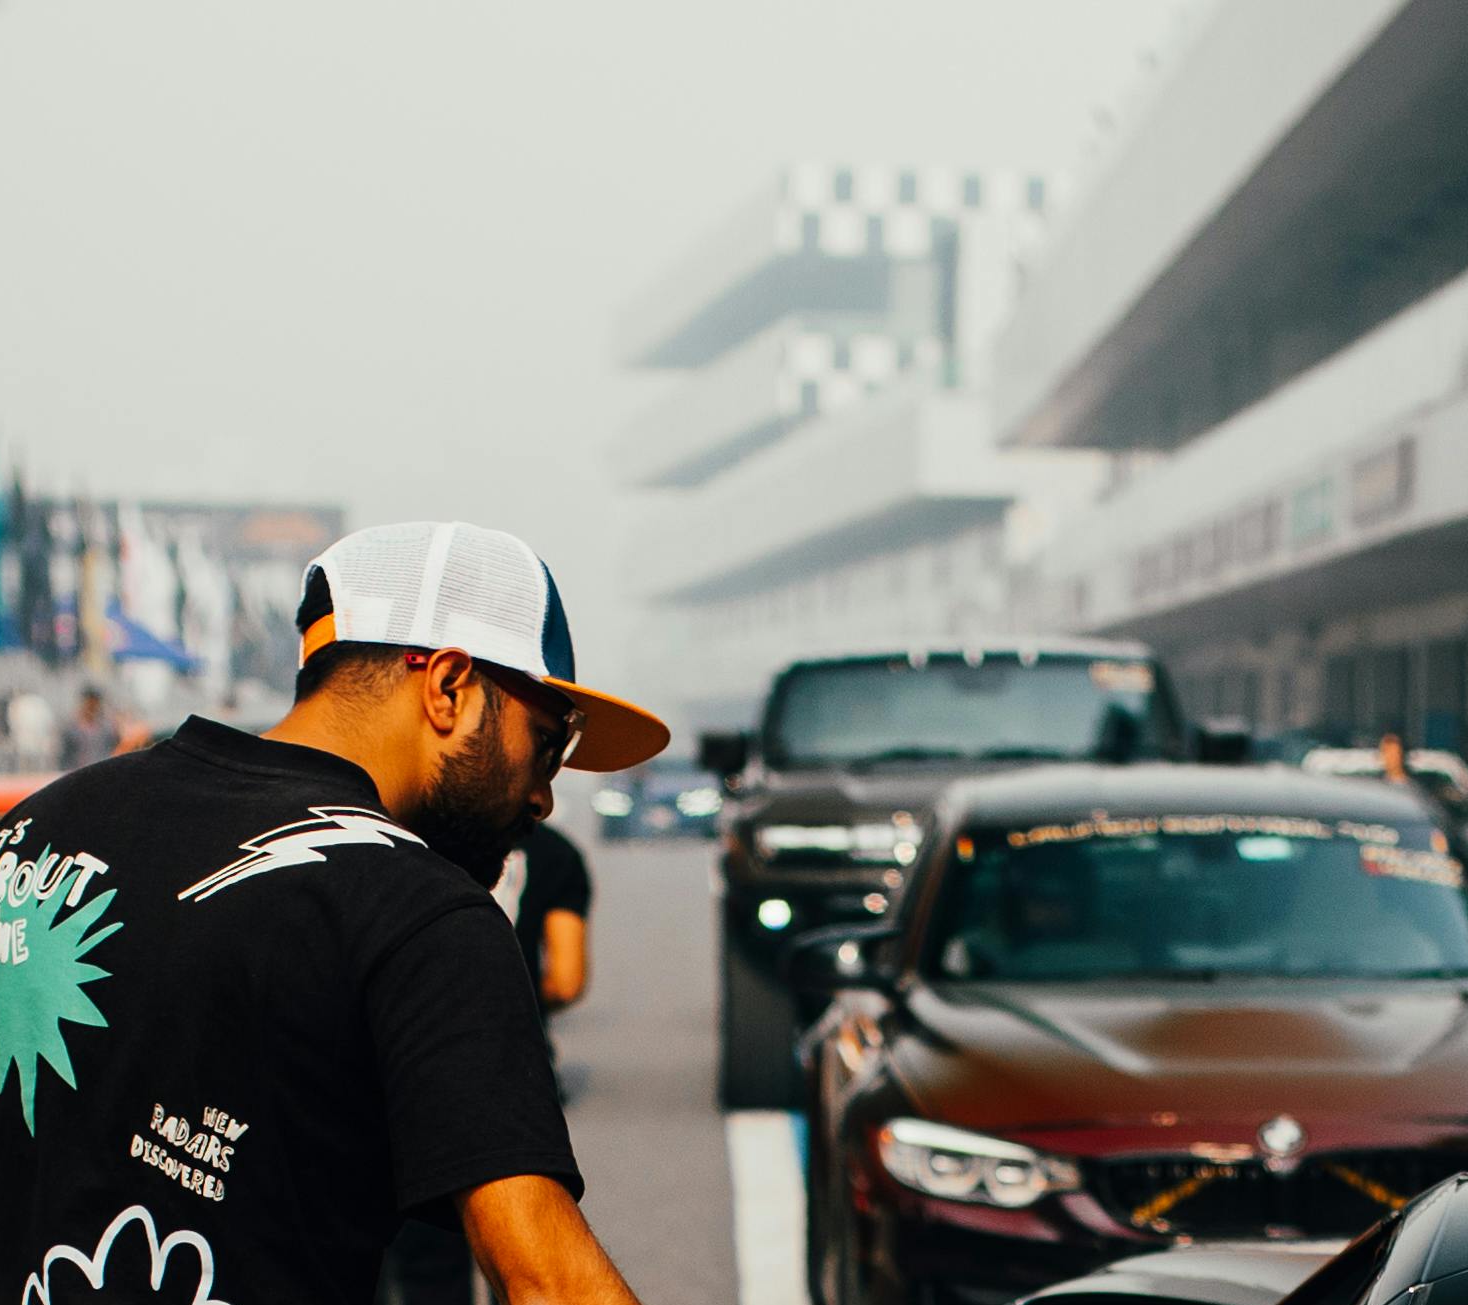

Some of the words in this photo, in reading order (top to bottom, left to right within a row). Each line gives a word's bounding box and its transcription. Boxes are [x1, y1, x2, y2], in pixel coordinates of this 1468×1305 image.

[150, 1102, 235, 1173] RADARS
[202, 1106, 250, 1142] NEW
[130, 1133, 226, 1202] DISCOVERED
